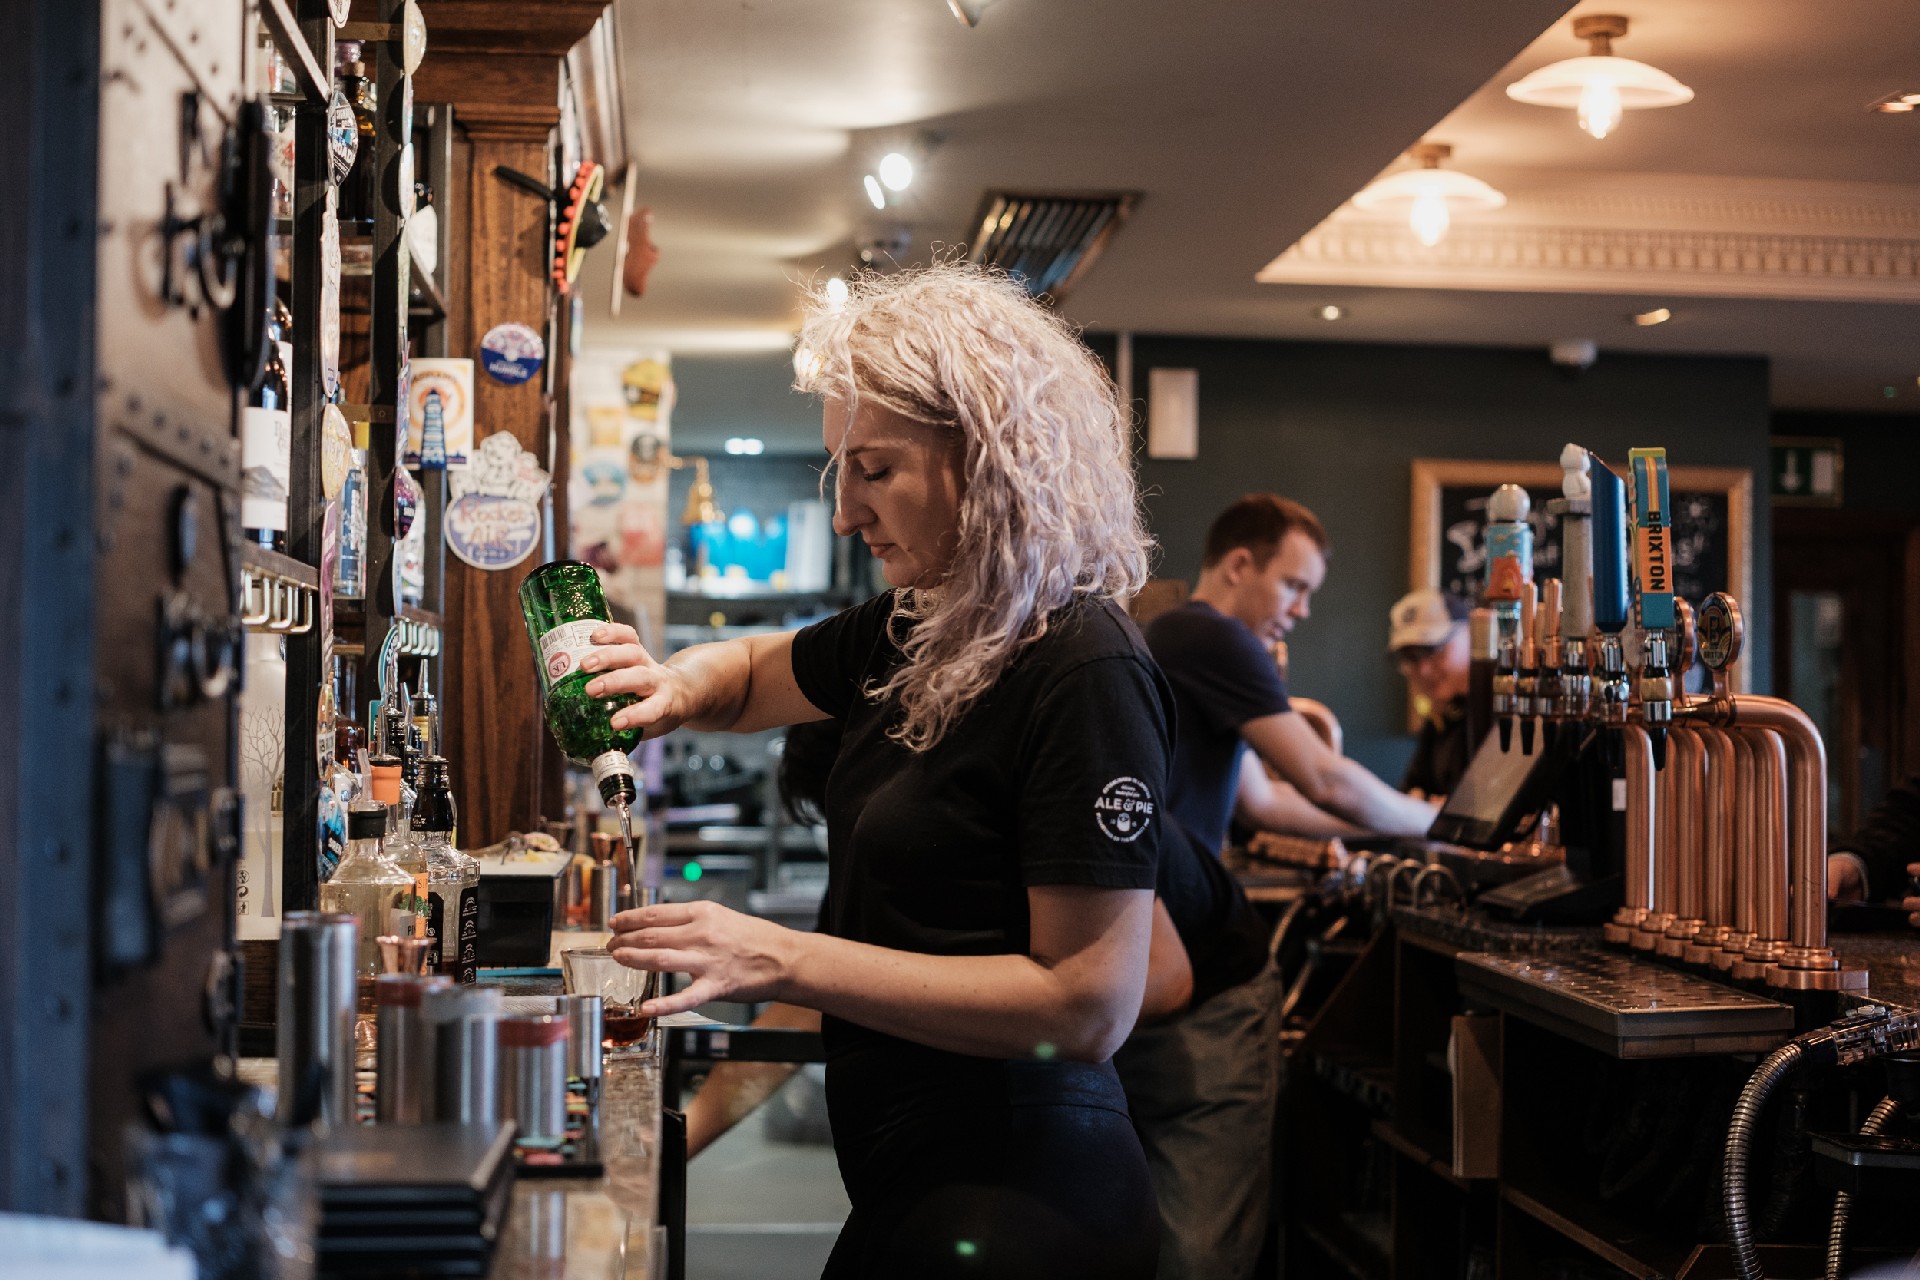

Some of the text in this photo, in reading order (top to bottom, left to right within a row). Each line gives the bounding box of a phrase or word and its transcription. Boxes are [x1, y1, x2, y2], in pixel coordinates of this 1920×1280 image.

[1648, 511, 1665, 590] BRIXTON
[1094, 796, 1154, 814] ALE & PIE
